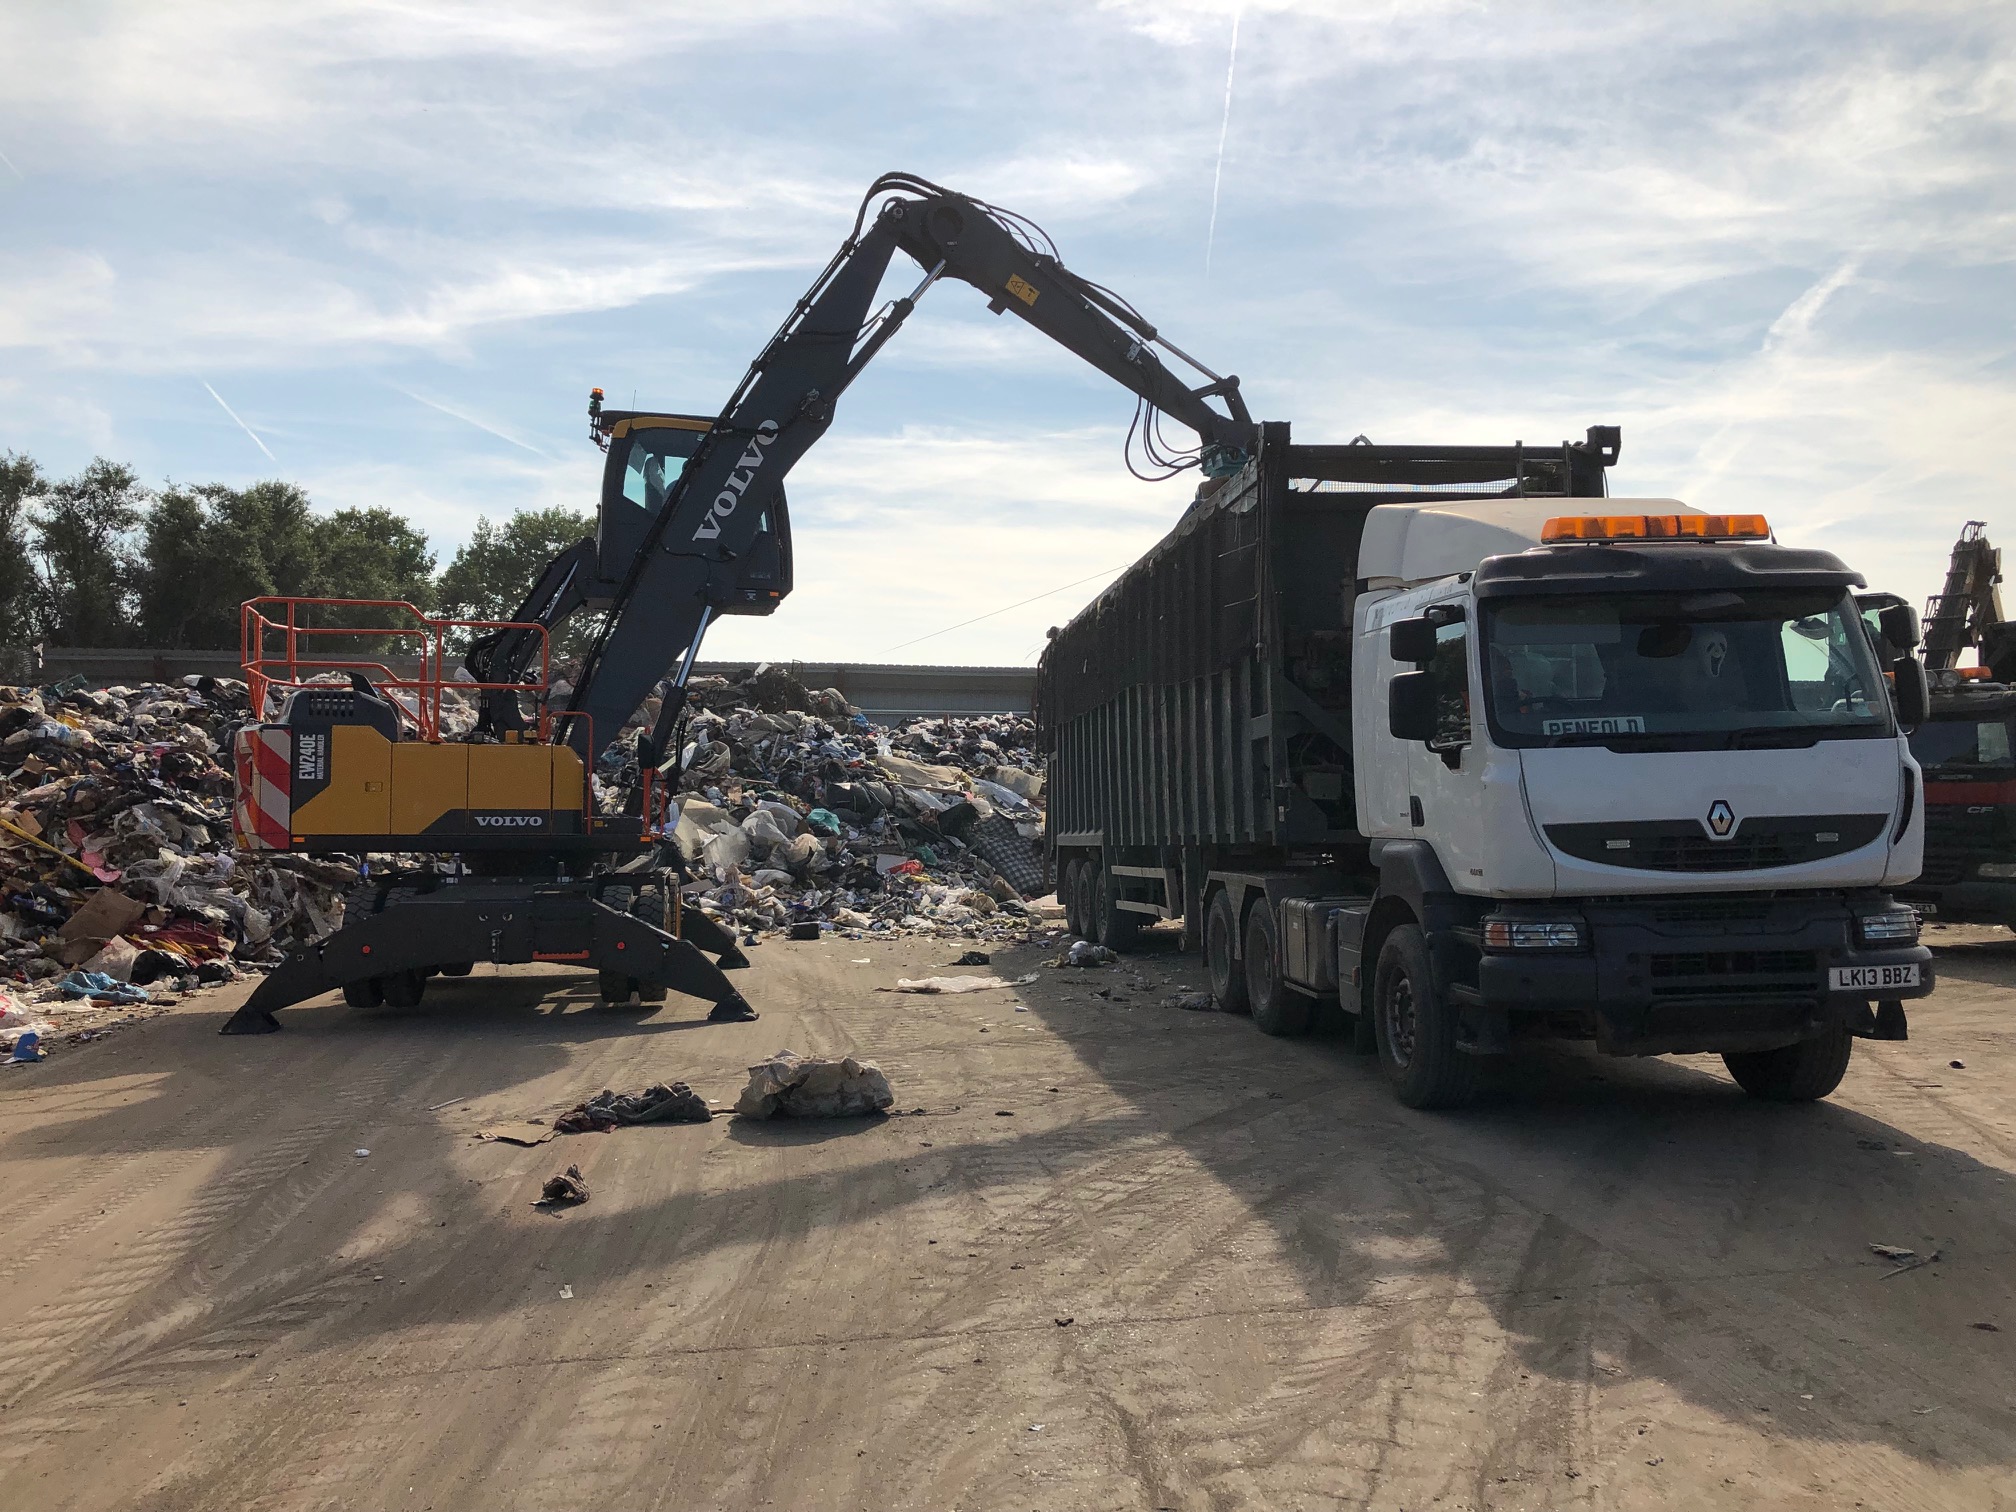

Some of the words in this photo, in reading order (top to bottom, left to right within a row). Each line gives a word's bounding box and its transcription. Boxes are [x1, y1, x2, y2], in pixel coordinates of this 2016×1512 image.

[692, 420, 779, 541] VOLVO
[299, 734, 316, 779] EW240E
[316, 756, 324, 780] MATERIAL
[474, 816, 543, 826] VOLVO
[1840, 969, 1878, 986] LK13
[1882, 967, 1912, 984] BBZ
